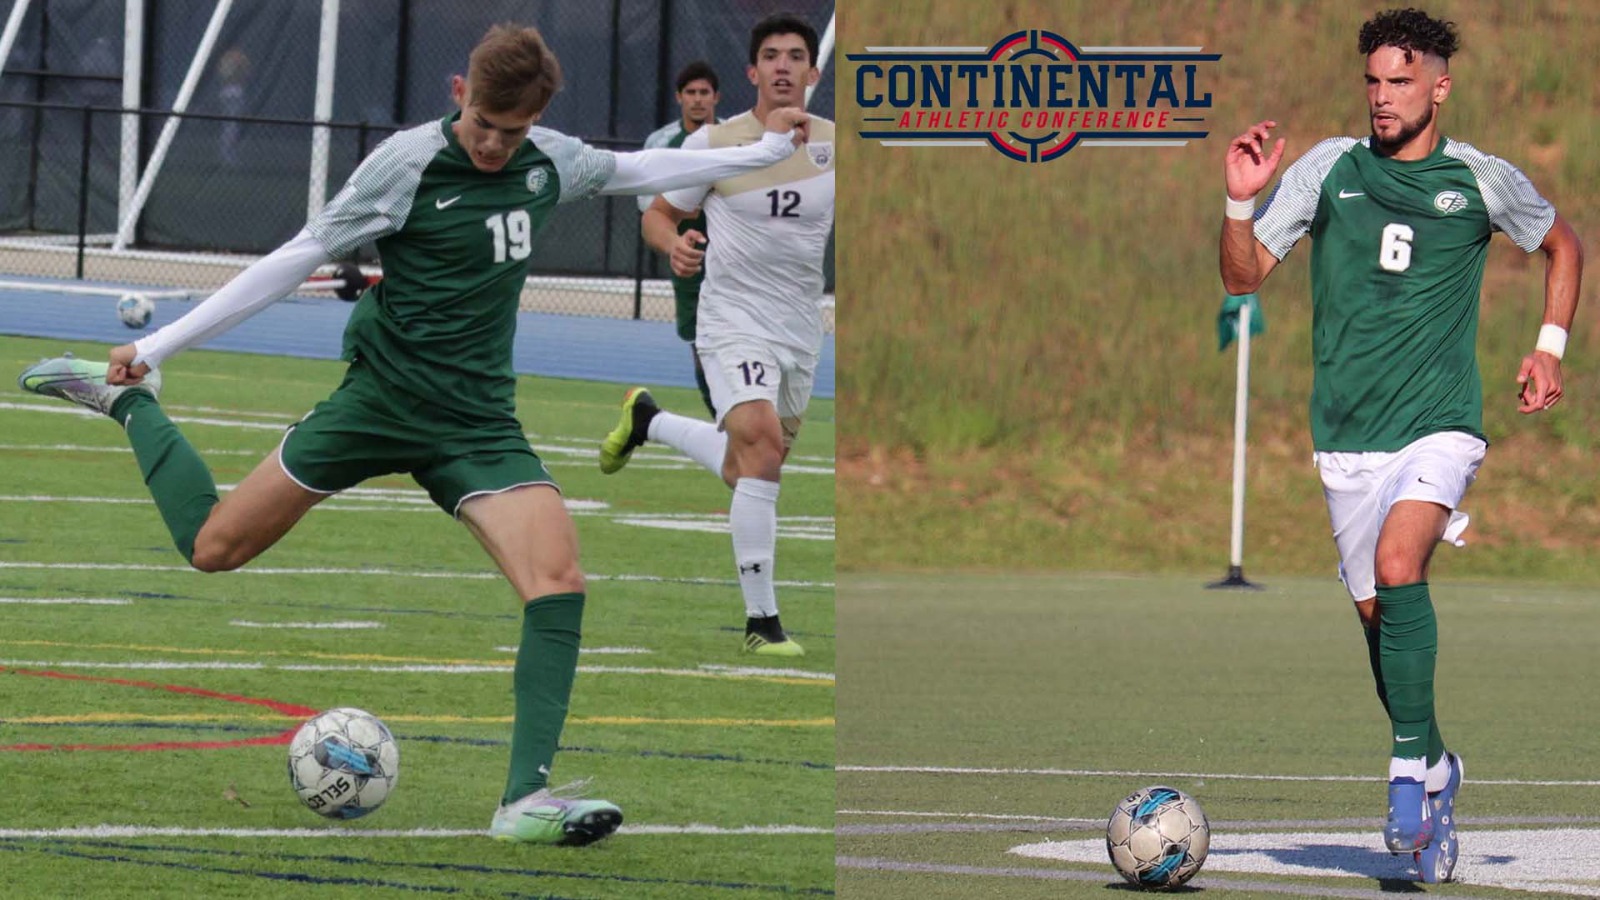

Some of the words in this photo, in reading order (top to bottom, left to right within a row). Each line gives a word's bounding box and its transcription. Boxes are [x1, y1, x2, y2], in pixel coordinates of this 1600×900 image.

[766, 189, 801, 218] 12
[486, 209, 532, 263] 19
[1379, 222, 1414, 272] 6
[737, 361, 768, 387] 12
